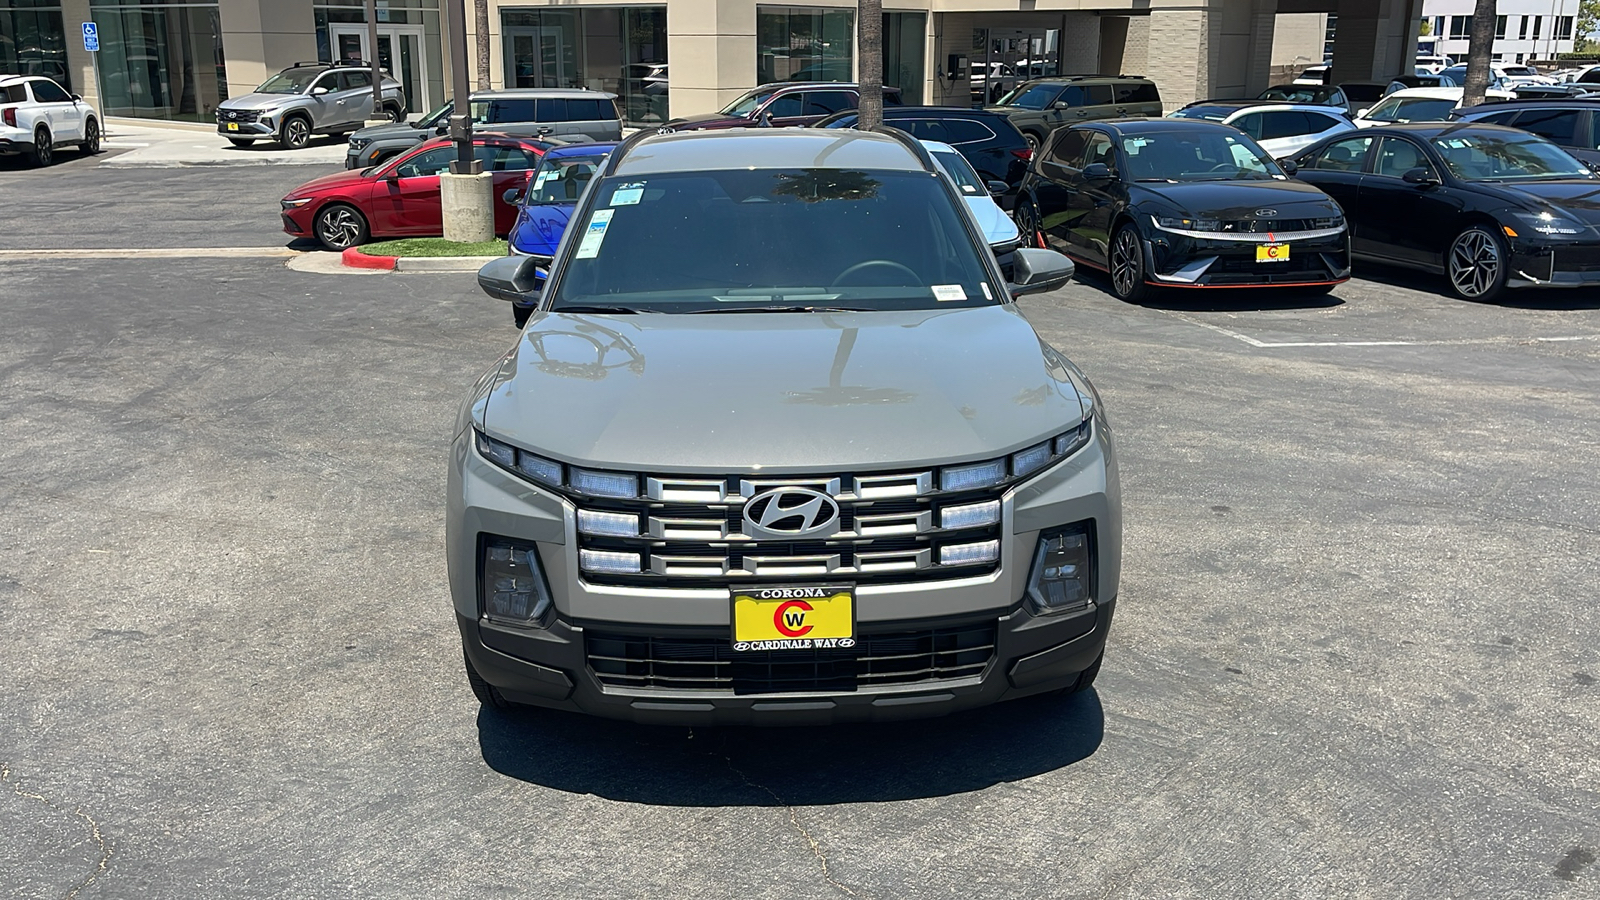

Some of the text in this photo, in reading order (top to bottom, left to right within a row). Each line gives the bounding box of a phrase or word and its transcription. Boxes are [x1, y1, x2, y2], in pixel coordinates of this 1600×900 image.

[760, 588, 826, 599] CORONA
[773, 599, 814, 638] C
[785, 612, 805, 627] W
[750, 638, 838, 651] CARDINALE WAY
